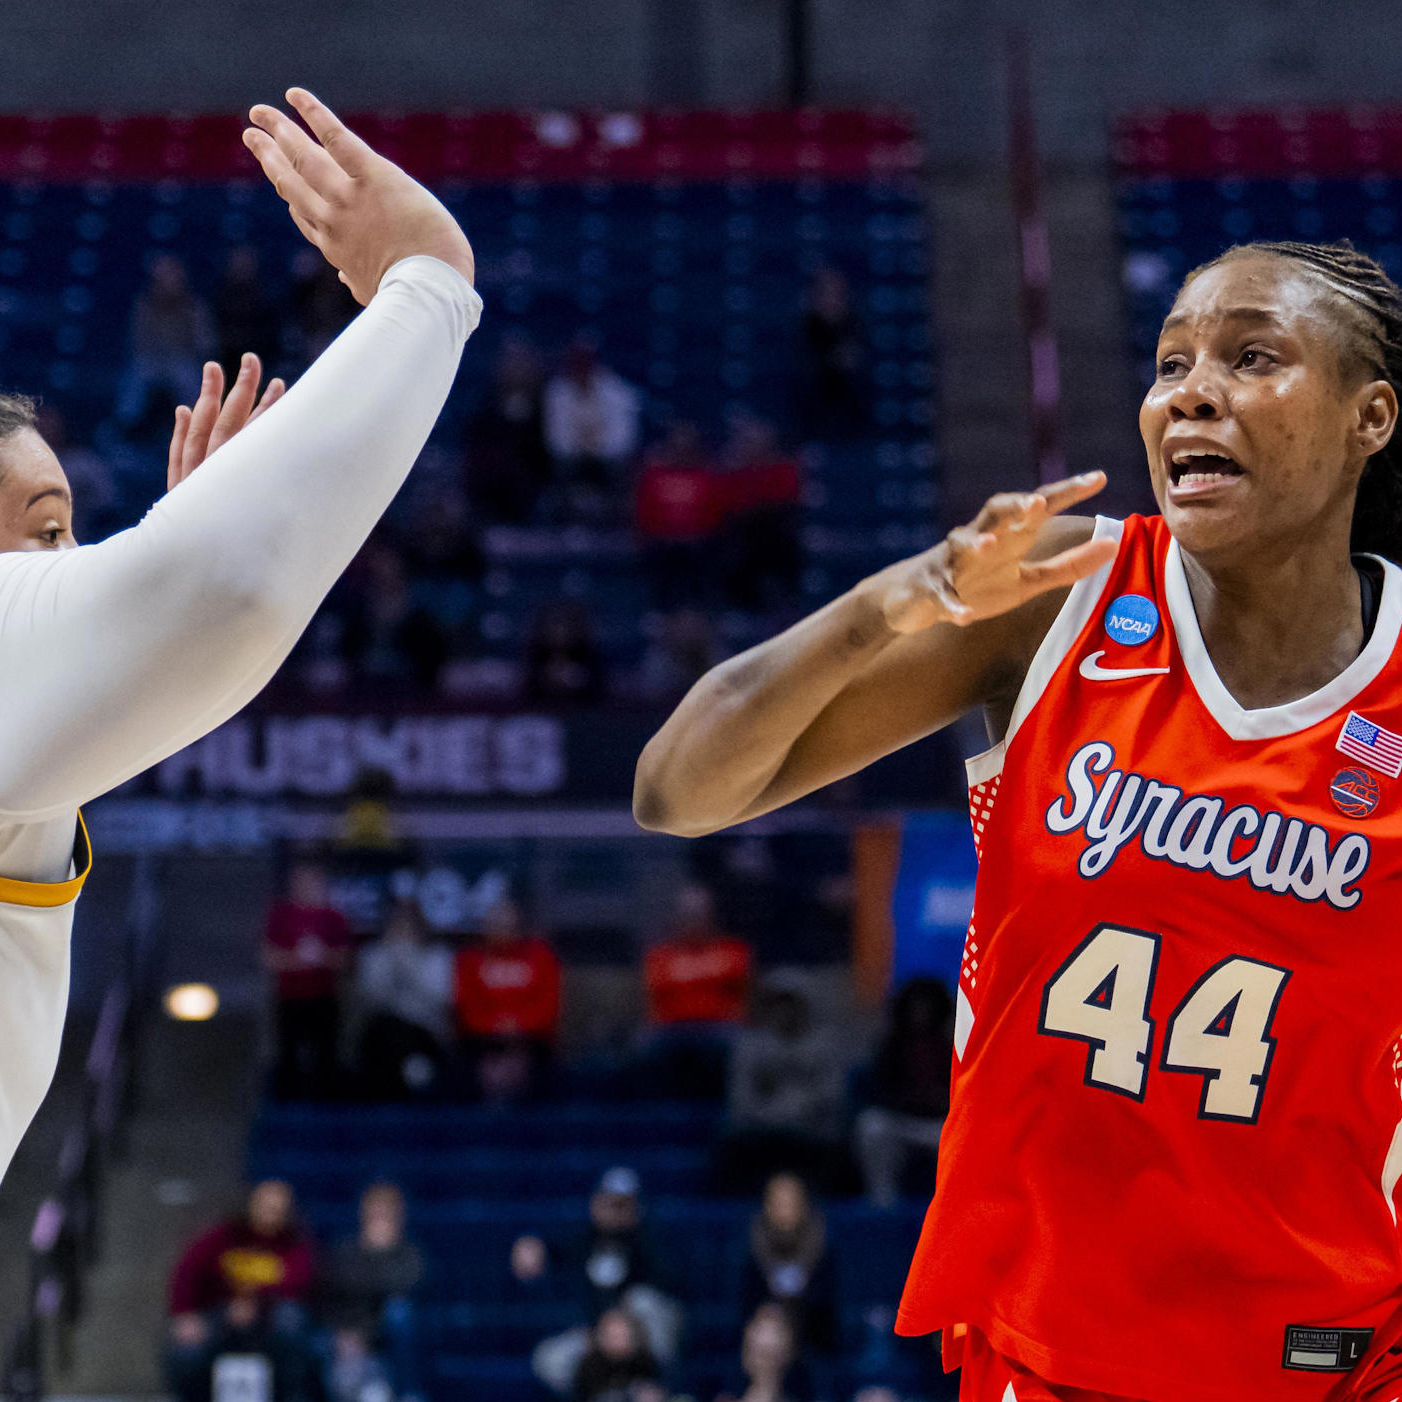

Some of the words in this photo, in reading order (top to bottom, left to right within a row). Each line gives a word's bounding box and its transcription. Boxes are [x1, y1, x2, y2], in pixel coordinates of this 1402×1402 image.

[1108, 615, 1152, 637] NCAA
[160, 714, 564, 794] HUSKIES
[1335, 780, 1381, 804] ACC
[1045, 740, 1371, 910] Syracuse
[1037, 921, 1294, 1125] 44
[1350, 1342, 1357, 1358] L
